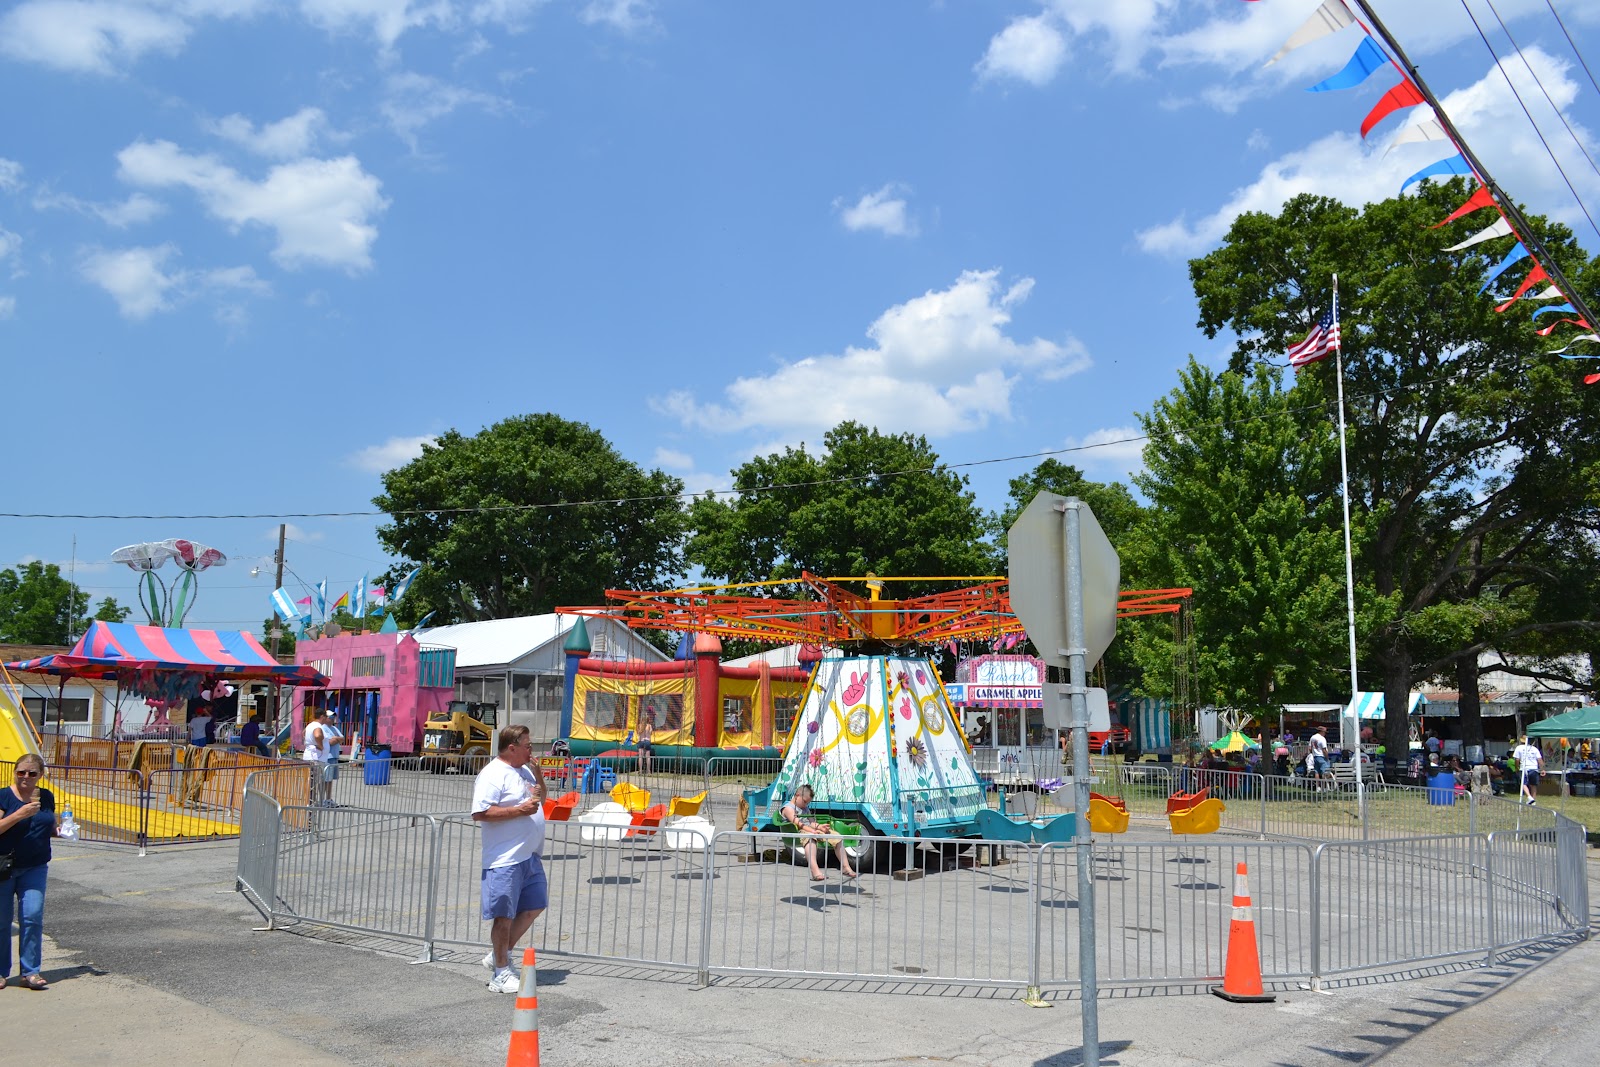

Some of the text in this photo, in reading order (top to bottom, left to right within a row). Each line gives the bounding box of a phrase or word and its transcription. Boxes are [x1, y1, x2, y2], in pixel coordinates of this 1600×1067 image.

[980, 664, 1035, 682] Rascal's
[976, 688, 1014, 699] CARAMEL
[424, 734, 442, 749] CAT
[541, 758, 563, 766] EXIT
